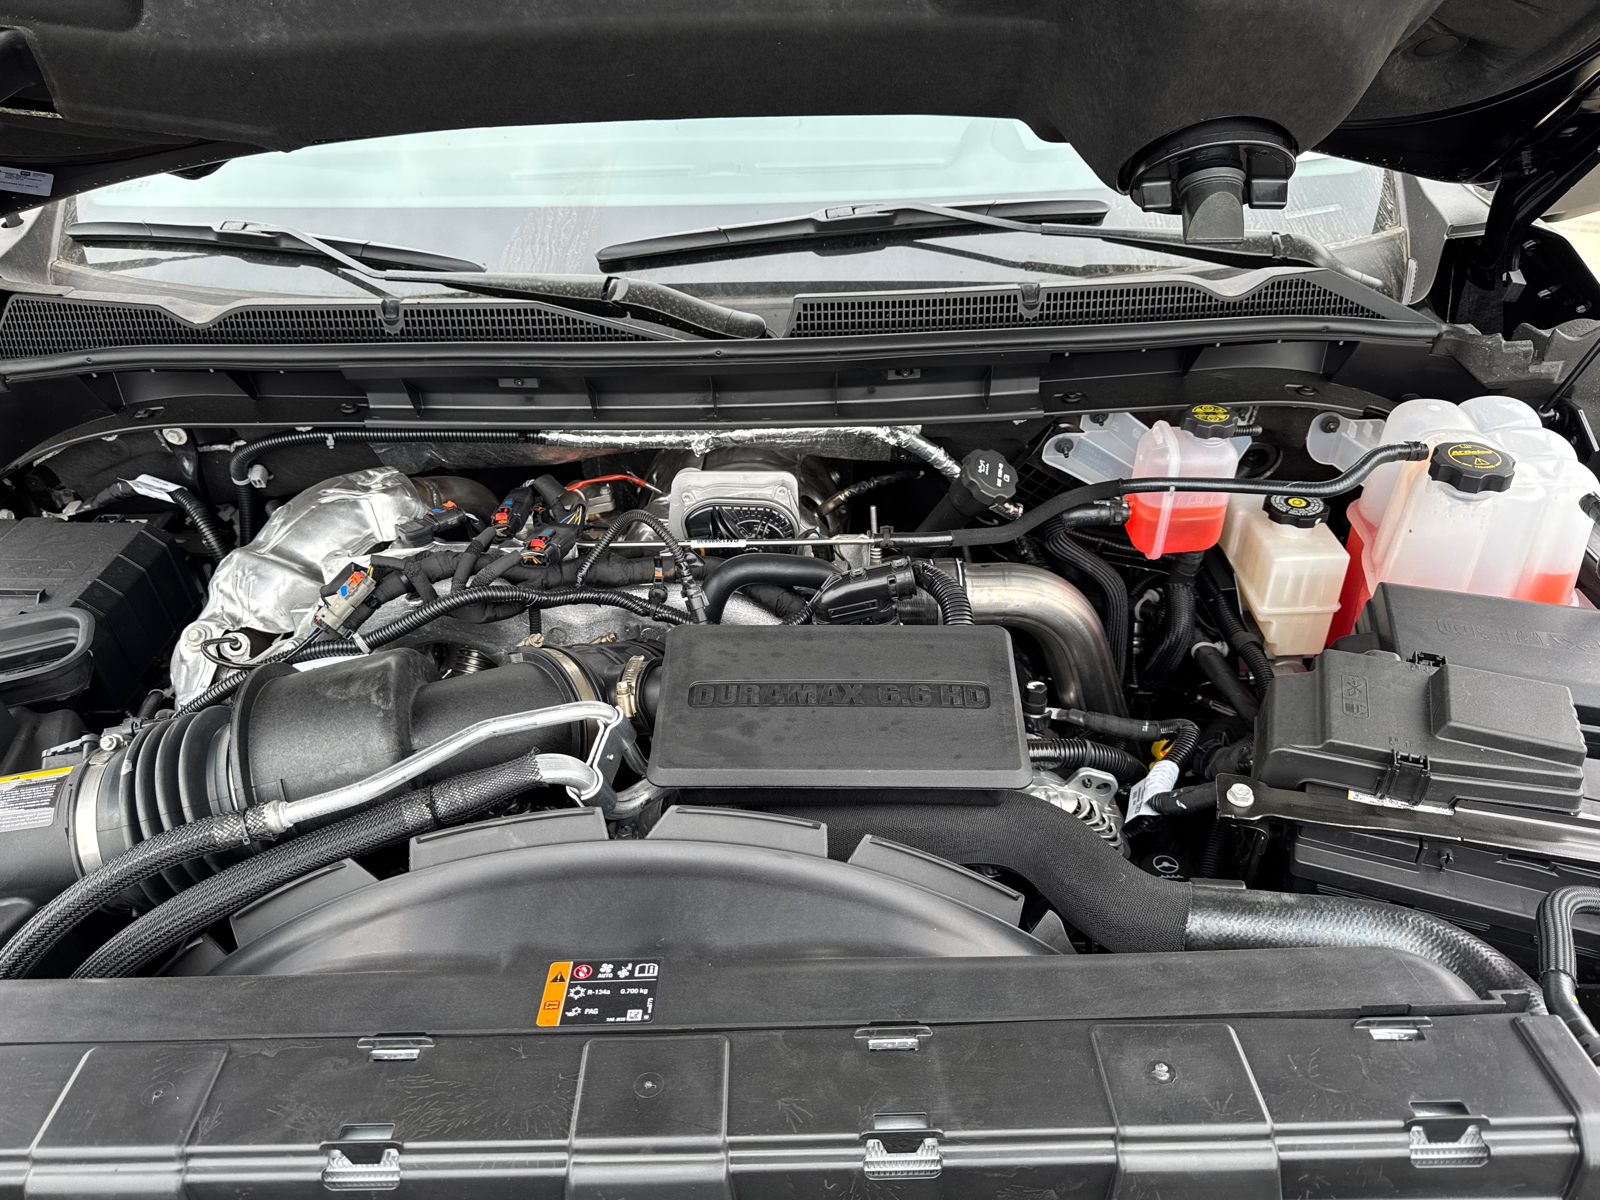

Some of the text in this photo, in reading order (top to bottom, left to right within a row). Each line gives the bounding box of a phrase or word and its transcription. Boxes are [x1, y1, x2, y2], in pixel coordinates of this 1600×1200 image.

[692, 684, 988, 708] DURAMAX 6.6 HD
[620, 987, 638, 995] 0.700
[639, 987, 648, 995] kg
